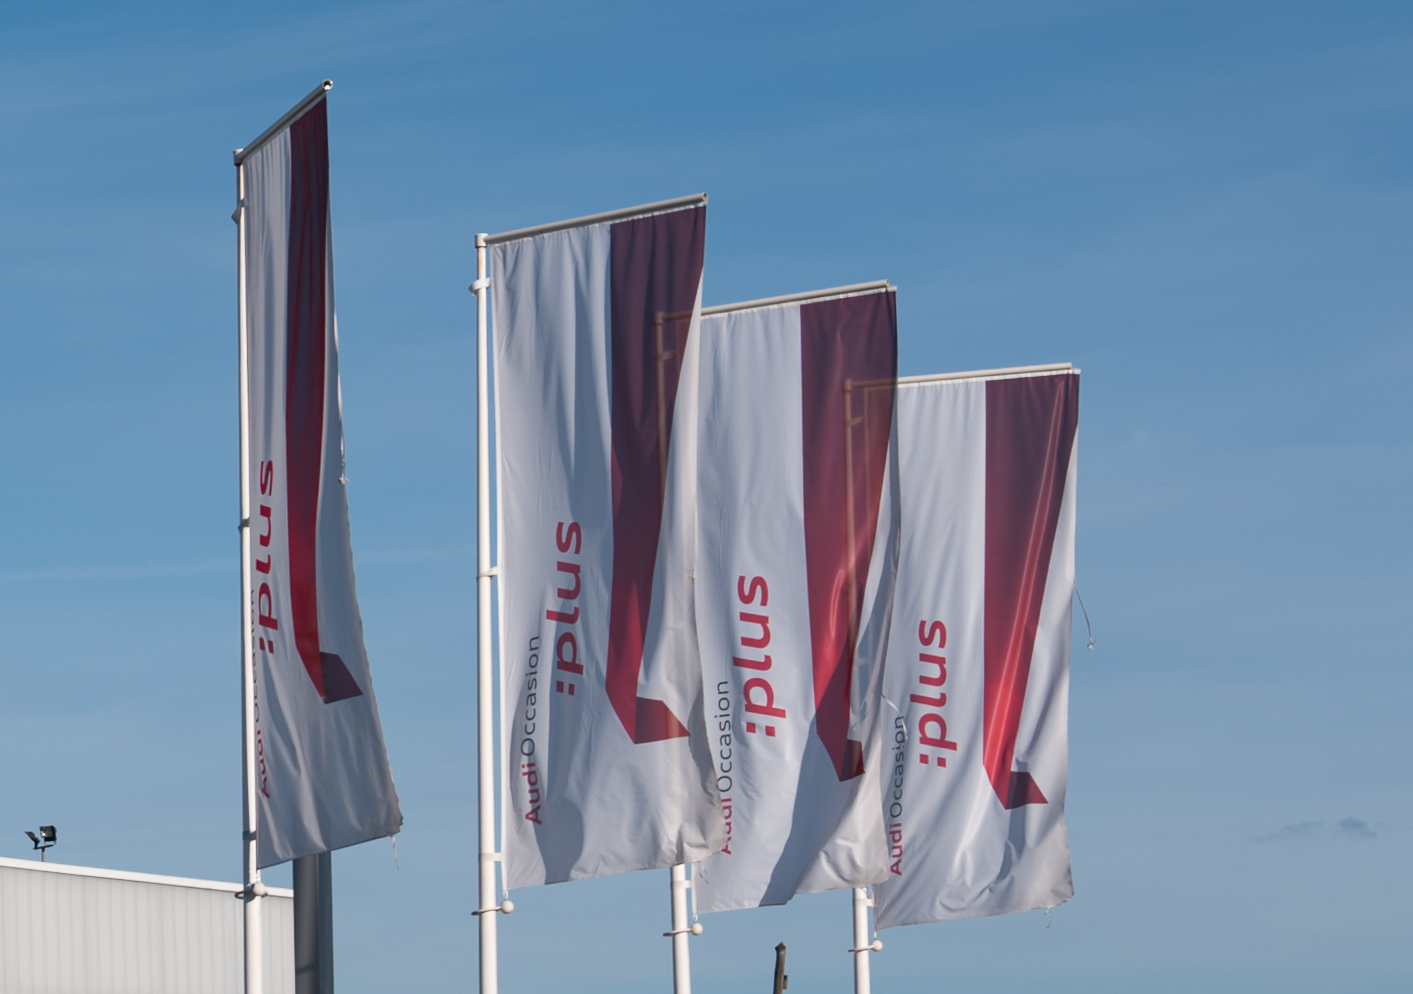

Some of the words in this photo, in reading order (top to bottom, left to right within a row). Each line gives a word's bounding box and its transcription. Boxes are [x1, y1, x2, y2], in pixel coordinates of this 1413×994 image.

[256, 460, 278, 654] :plus
[546, 521, 584, 696] :plus
[520, 636, 540, 756] Occasion
[732, 575, 786, 737] :plus
[909, 620, 957, 768] :plus
[522, 762, 542, 825] Audi
[714, 680, 733, 793] Occasion
[888, 716, 905, 818] Occasion
[889, 822, 902, 876] Audi
